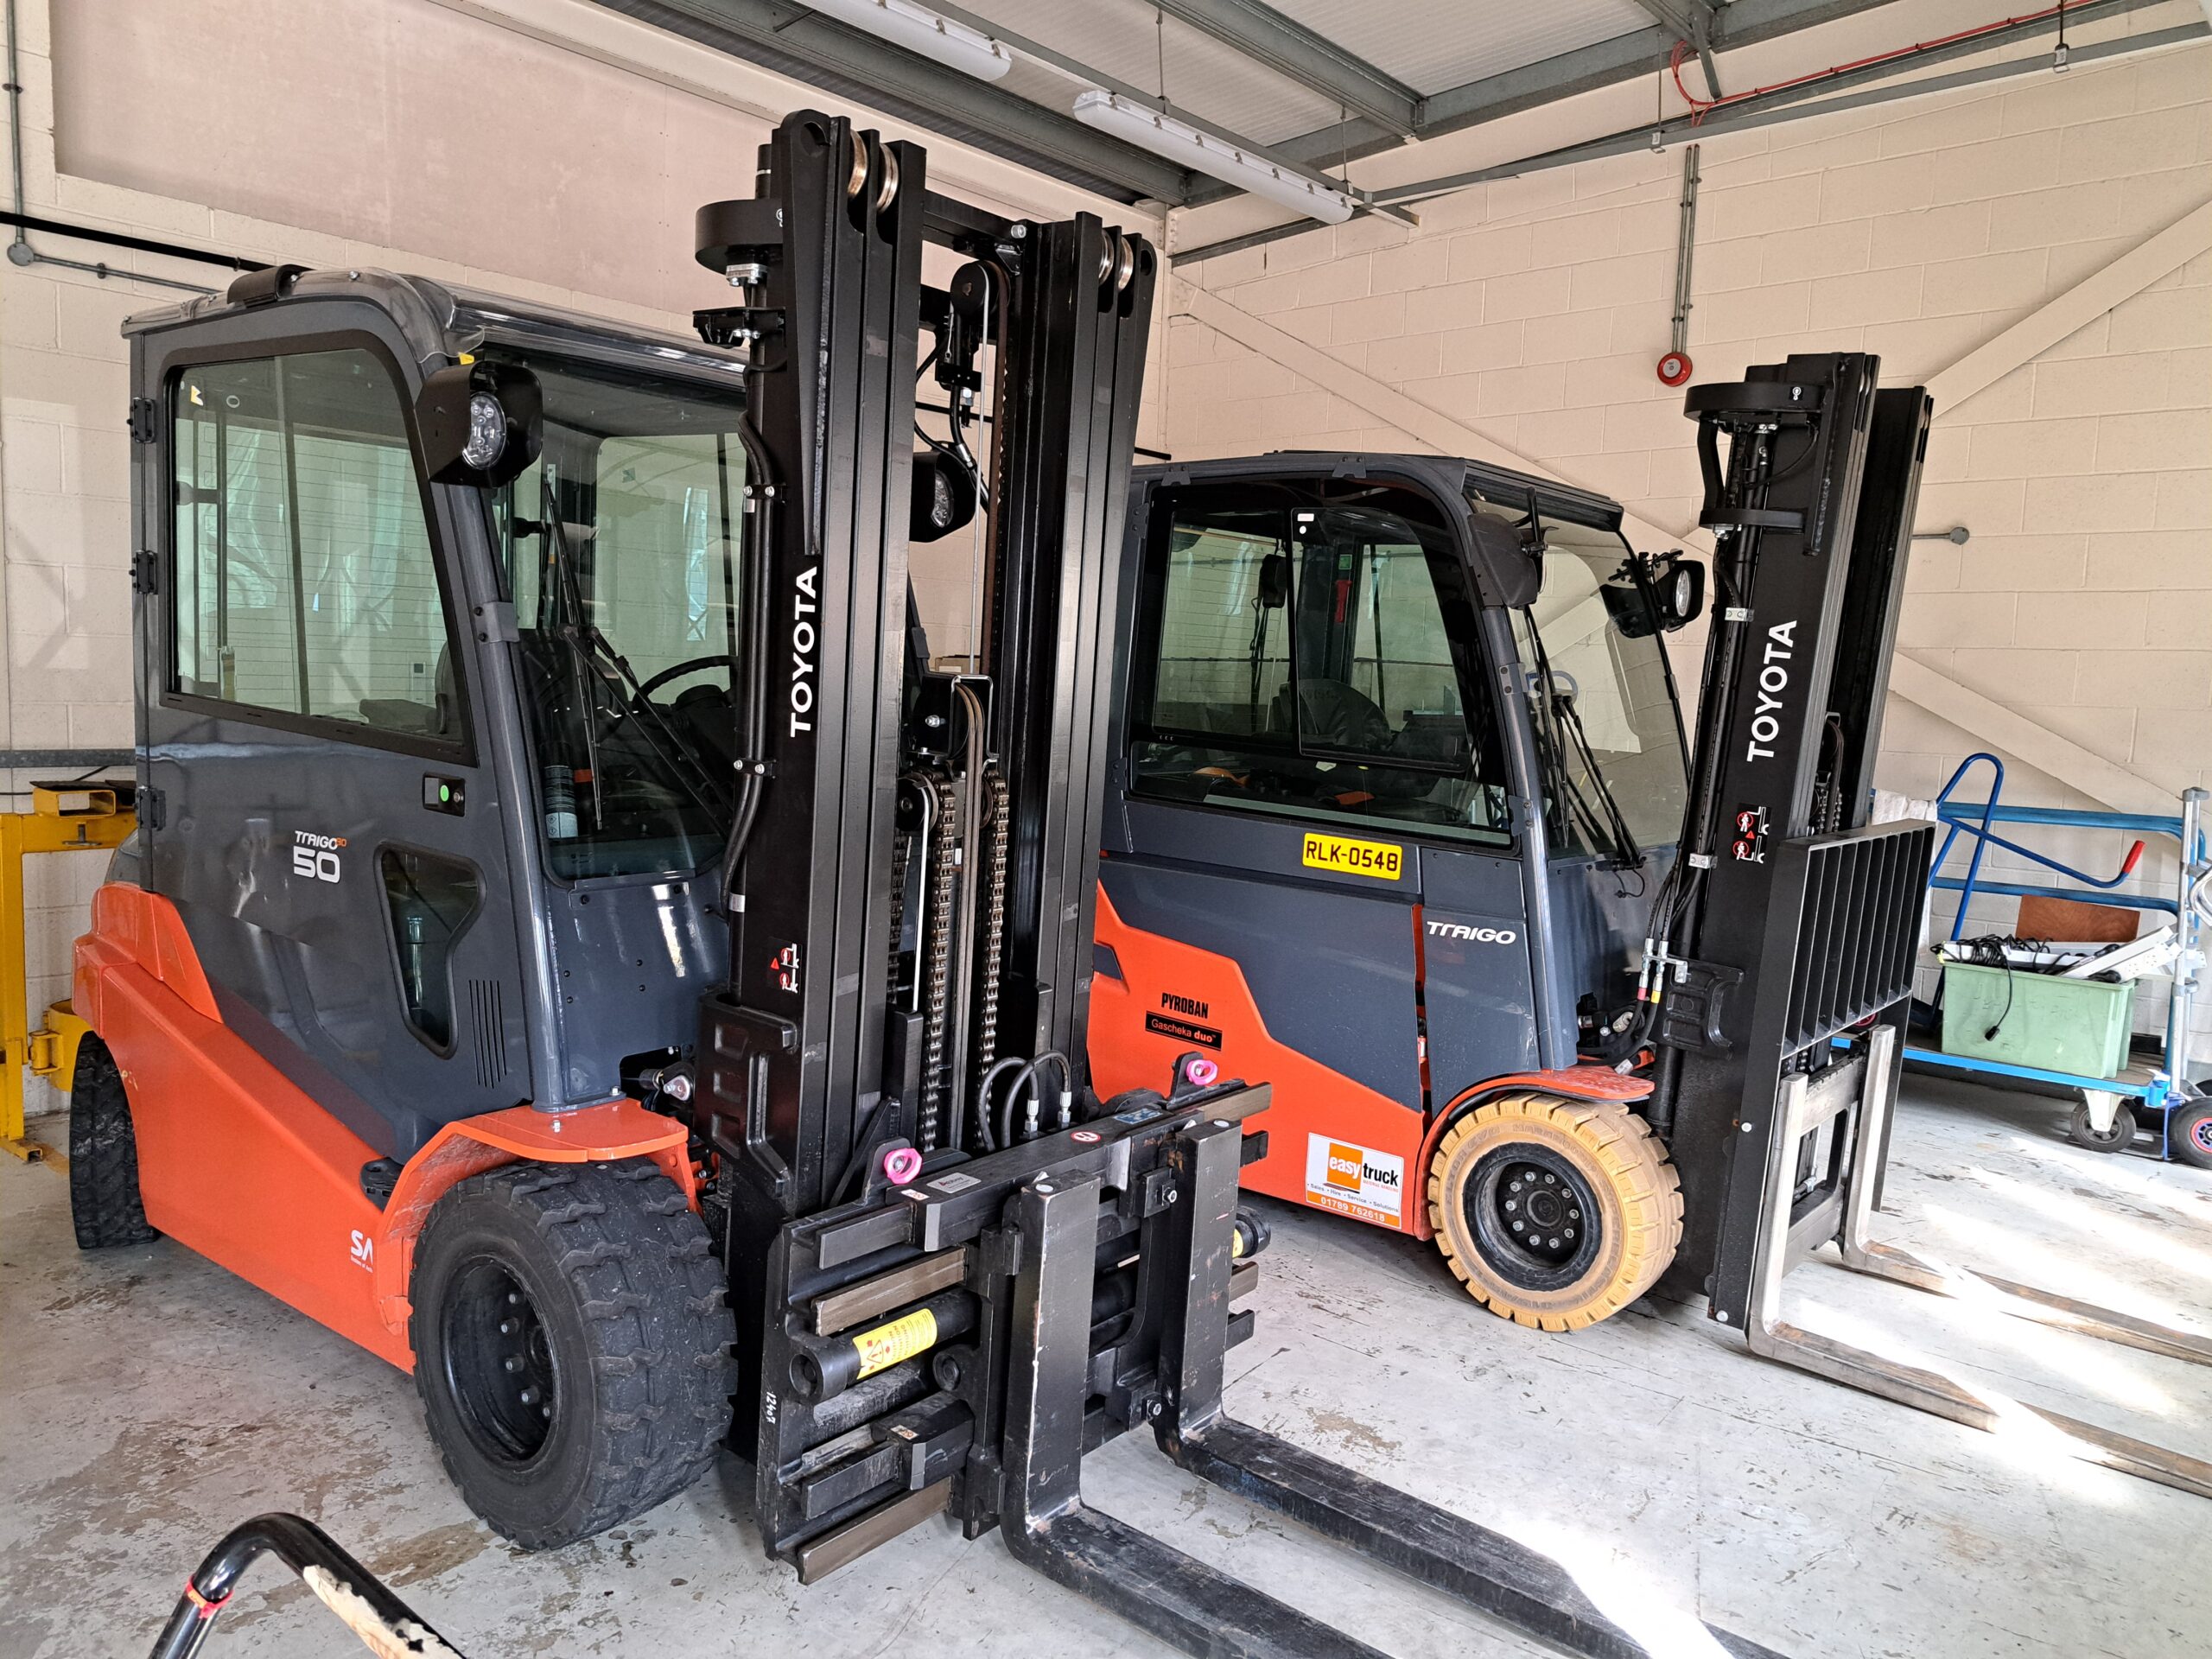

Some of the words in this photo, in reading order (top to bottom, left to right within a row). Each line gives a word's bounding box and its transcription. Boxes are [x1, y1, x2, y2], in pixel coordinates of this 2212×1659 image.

[790, 566, 817, 738] TOYOTA
[1746, 620, 1797, 762] TOYOTA
[293, 845, 340, 883] 50
[1306, 840, 1398, 872] RLK-0548
[1160, 992, 1209, 1020] PYROBAN
[1151, 1018, 1192, 1038] Gascheka
[1329, 1156, 1362, 1179] easy
[1363, 1162, 1399, 1187] truck
[1320, 1196, 1349, 1211] 01789
[1351, 1205, 1386, 1223] 762618
